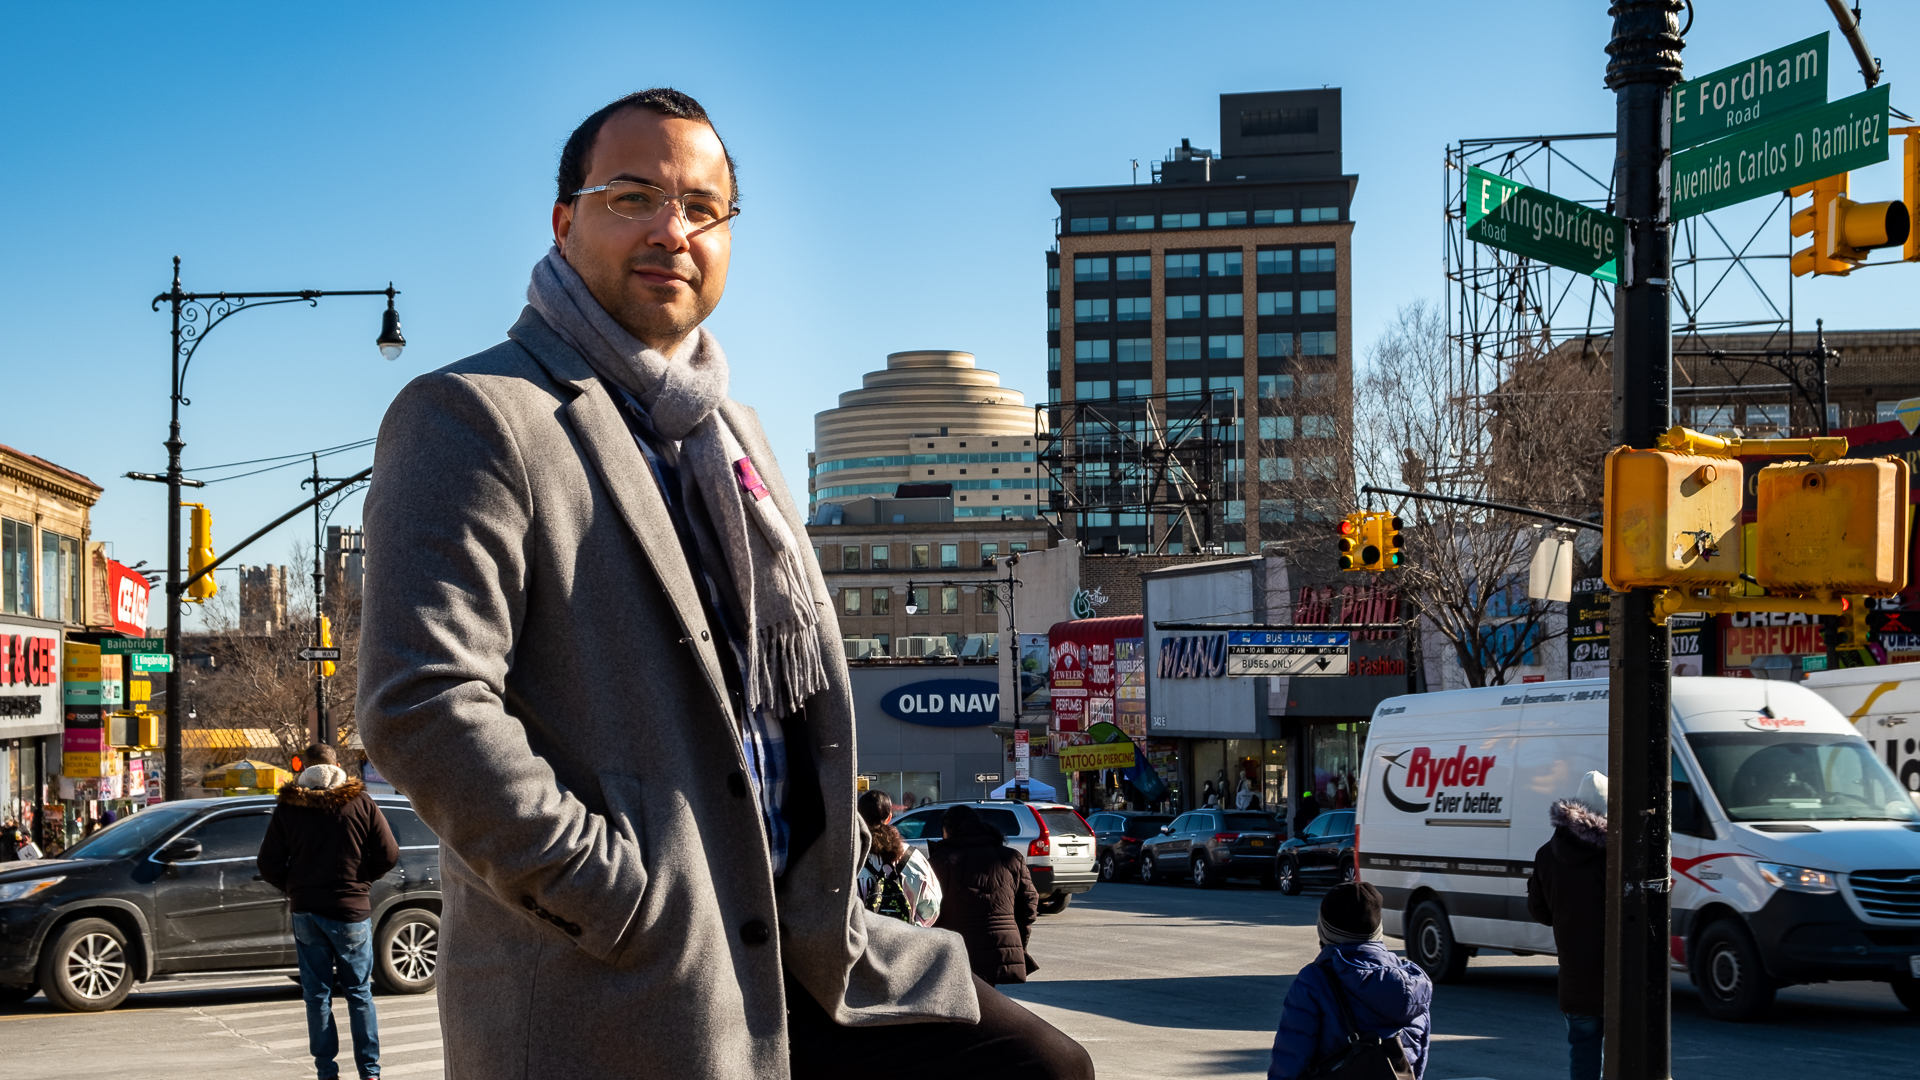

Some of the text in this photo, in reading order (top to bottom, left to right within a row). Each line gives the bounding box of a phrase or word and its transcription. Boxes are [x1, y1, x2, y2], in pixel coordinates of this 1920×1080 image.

[1675, 48, 1818, 123] E Fordham
[1726, 100, 1761, 128] Road
[1673, 112, 1880, 204] Avenida Carlos D Ramirez
[1481, 178, 1615, 260] E Kingsbridge
[1481, 218, 1507, 243] Road
[1573, 578, 1608, 592] JEW
[107, 639, 158, 651] Bainbridge
[1266, 634, 1313, 643] BUS LANE
[28, 636, 57, 685] CEE
[1057, 641, 1080, 662] ABBASI
[1116, 660, 1145, 673] WIRELESS
[1242, 660, 1293, 669] BUSES ONLY
[1359, 656, 1404, 676] Fashion
[1053, 670, 1085, 680] JEWELERS
[899, 693, 1000, 713] OLD NAV
[1055, 698, 1082, 711] PERFUMES
[1758, 717, 1806, 728] Ryder
[1060, 754, 1096, 769] TATTOO
[1096, 754, 1103, 765] &
[1103, 752, 1135, 765] PIERCING
[1405, 745, 1496, 797] Ryder
[1434, 792, 1503, 813] Ever better.
